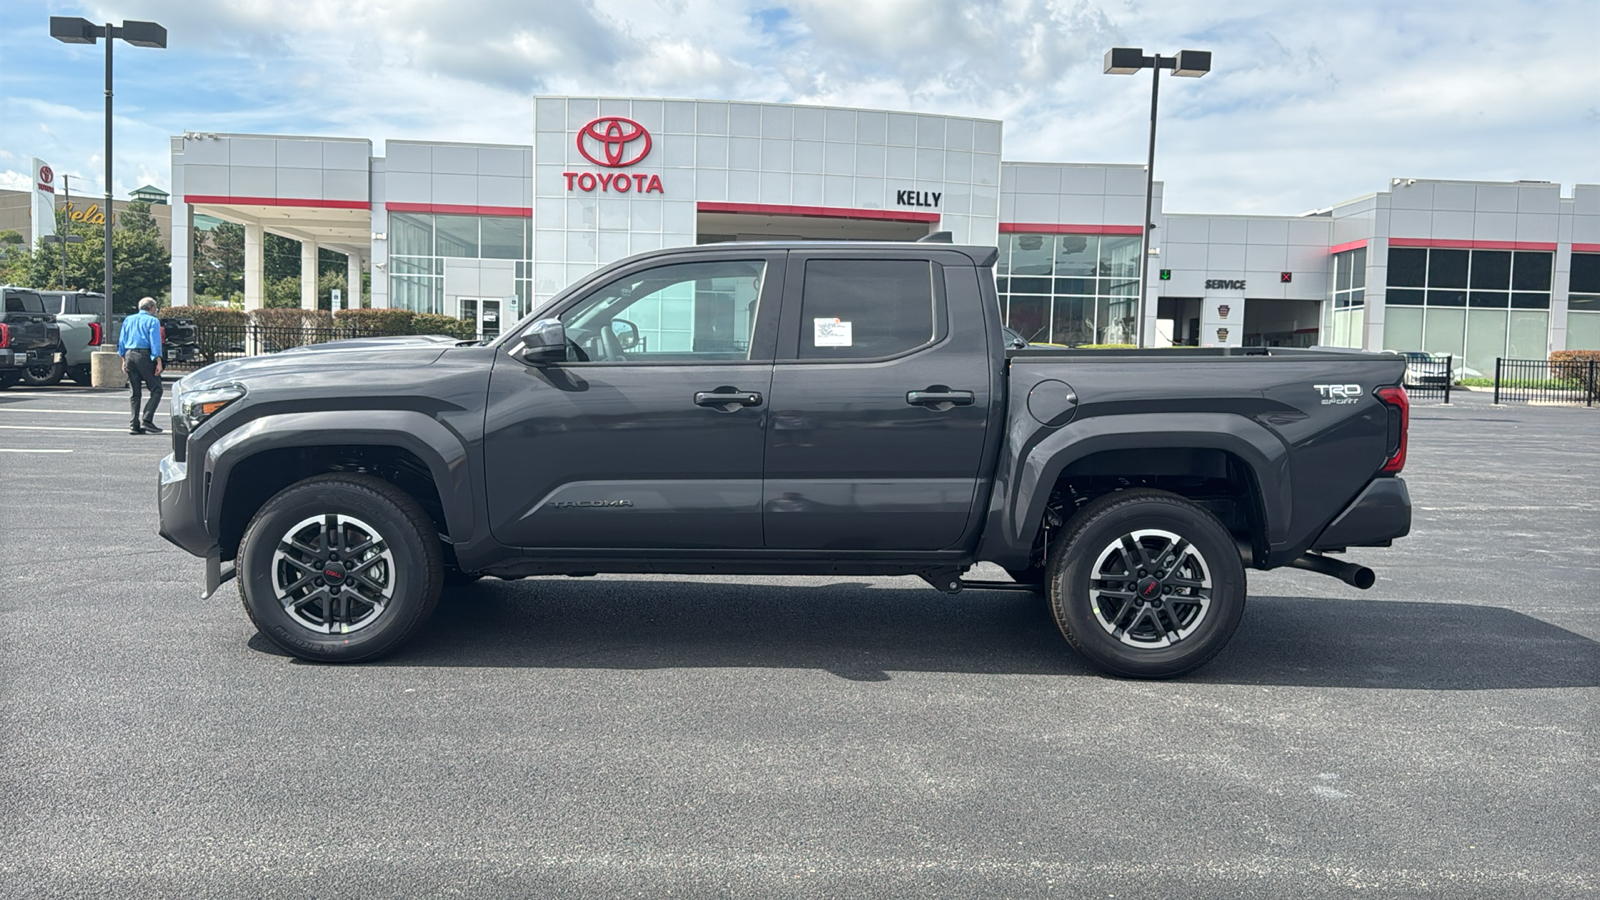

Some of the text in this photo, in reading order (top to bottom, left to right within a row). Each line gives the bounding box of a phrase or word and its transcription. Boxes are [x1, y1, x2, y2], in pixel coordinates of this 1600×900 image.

[563, 172, 664, 194] TOYOTA
[897, 189, 942, 207] KELLY
[1205, 279, 1246, 290] SERVICE
[1313, 384, 1362, 398] TRD
[550, 499, 634, 508] TACOMA
